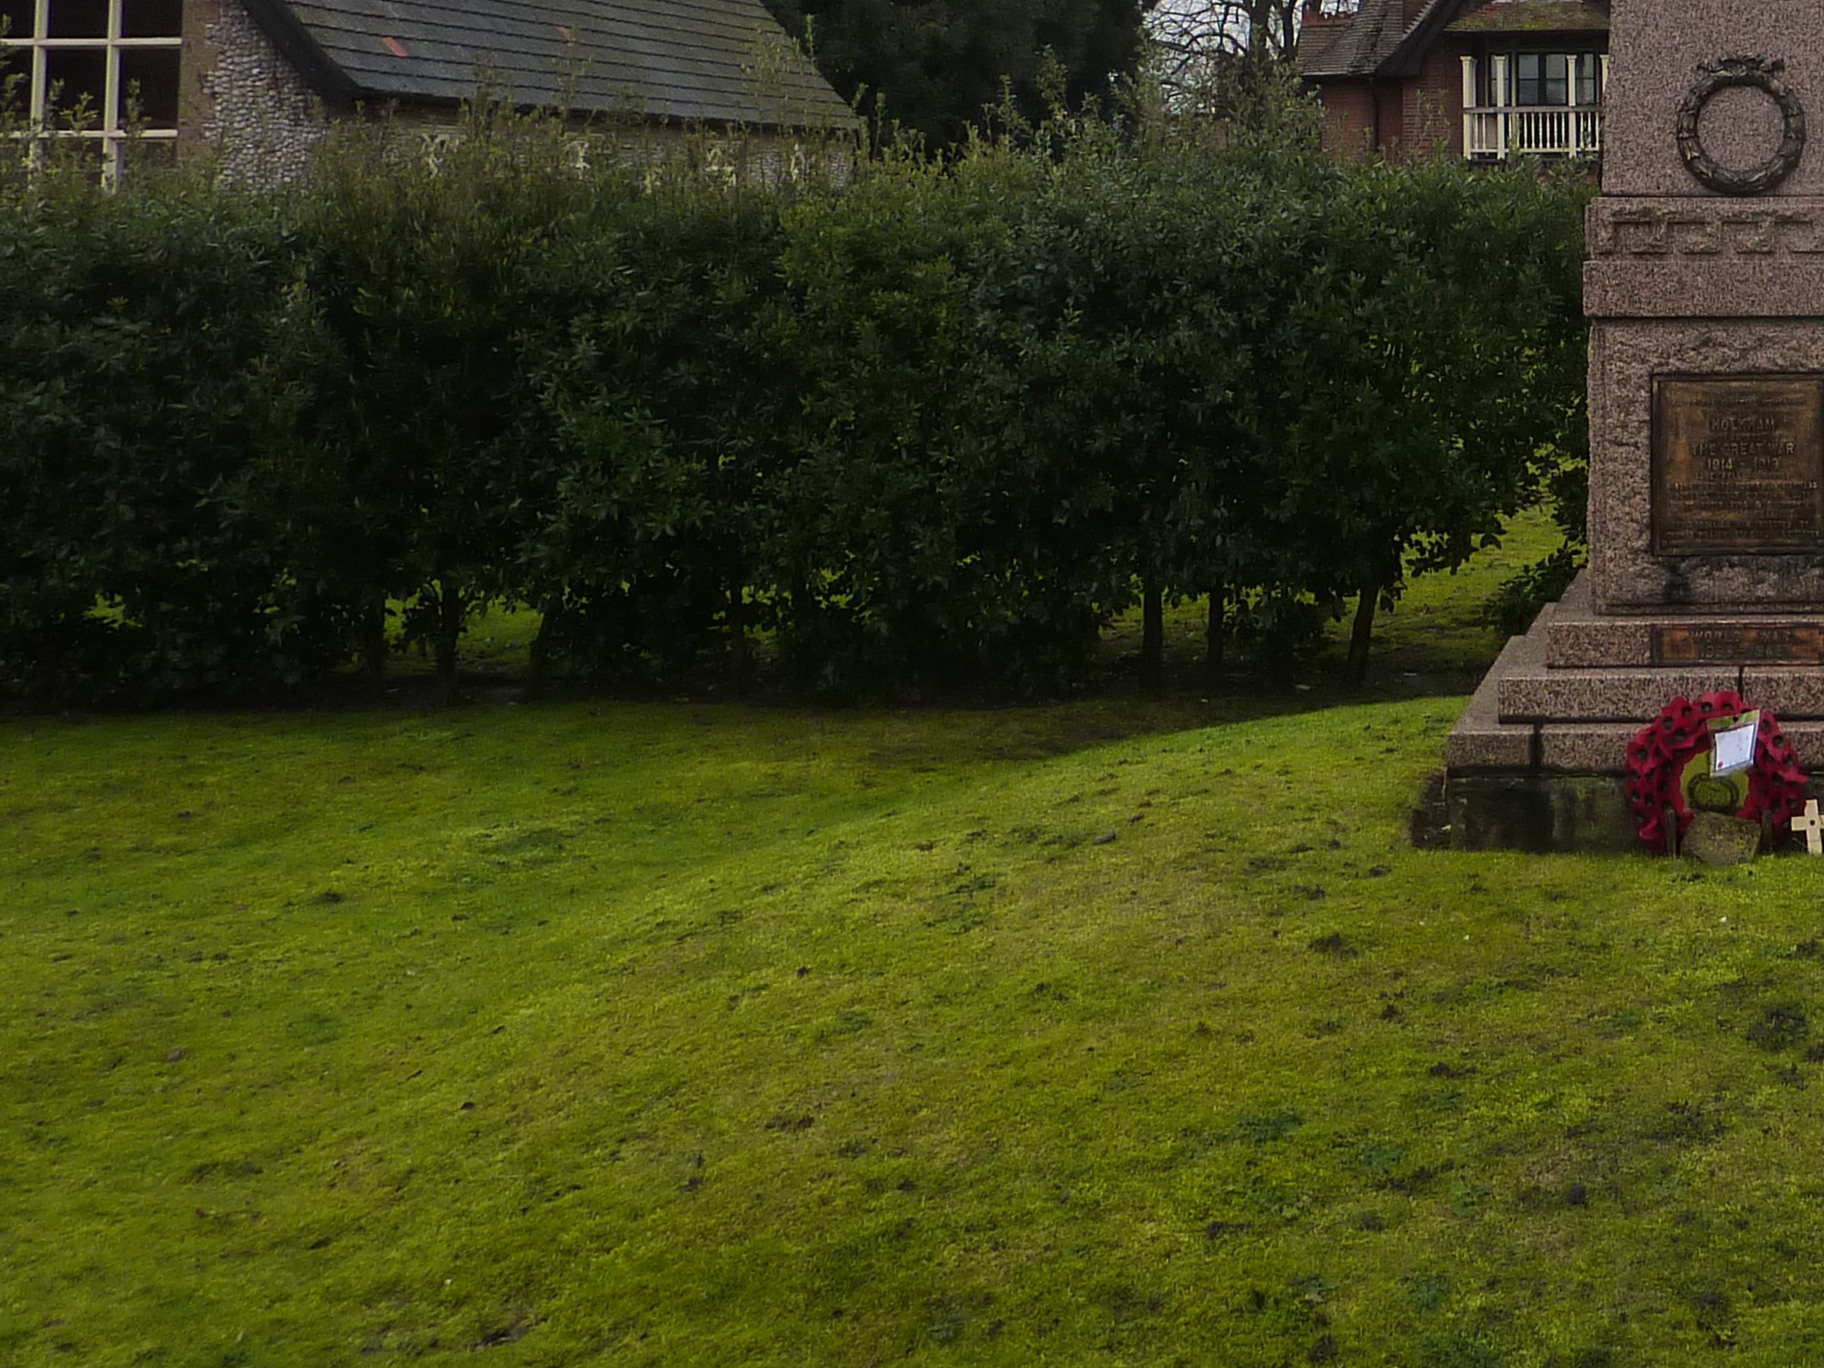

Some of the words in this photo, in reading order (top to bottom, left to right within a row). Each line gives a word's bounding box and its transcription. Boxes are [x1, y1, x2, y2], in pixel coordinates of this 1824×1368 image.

[1690, 442, 1717, 456] THE
[1722, 442, 1765, 456] GREAT
[1767, 442, 1795, 455] WAR
[1707, 457, 1734, 470] 1914
